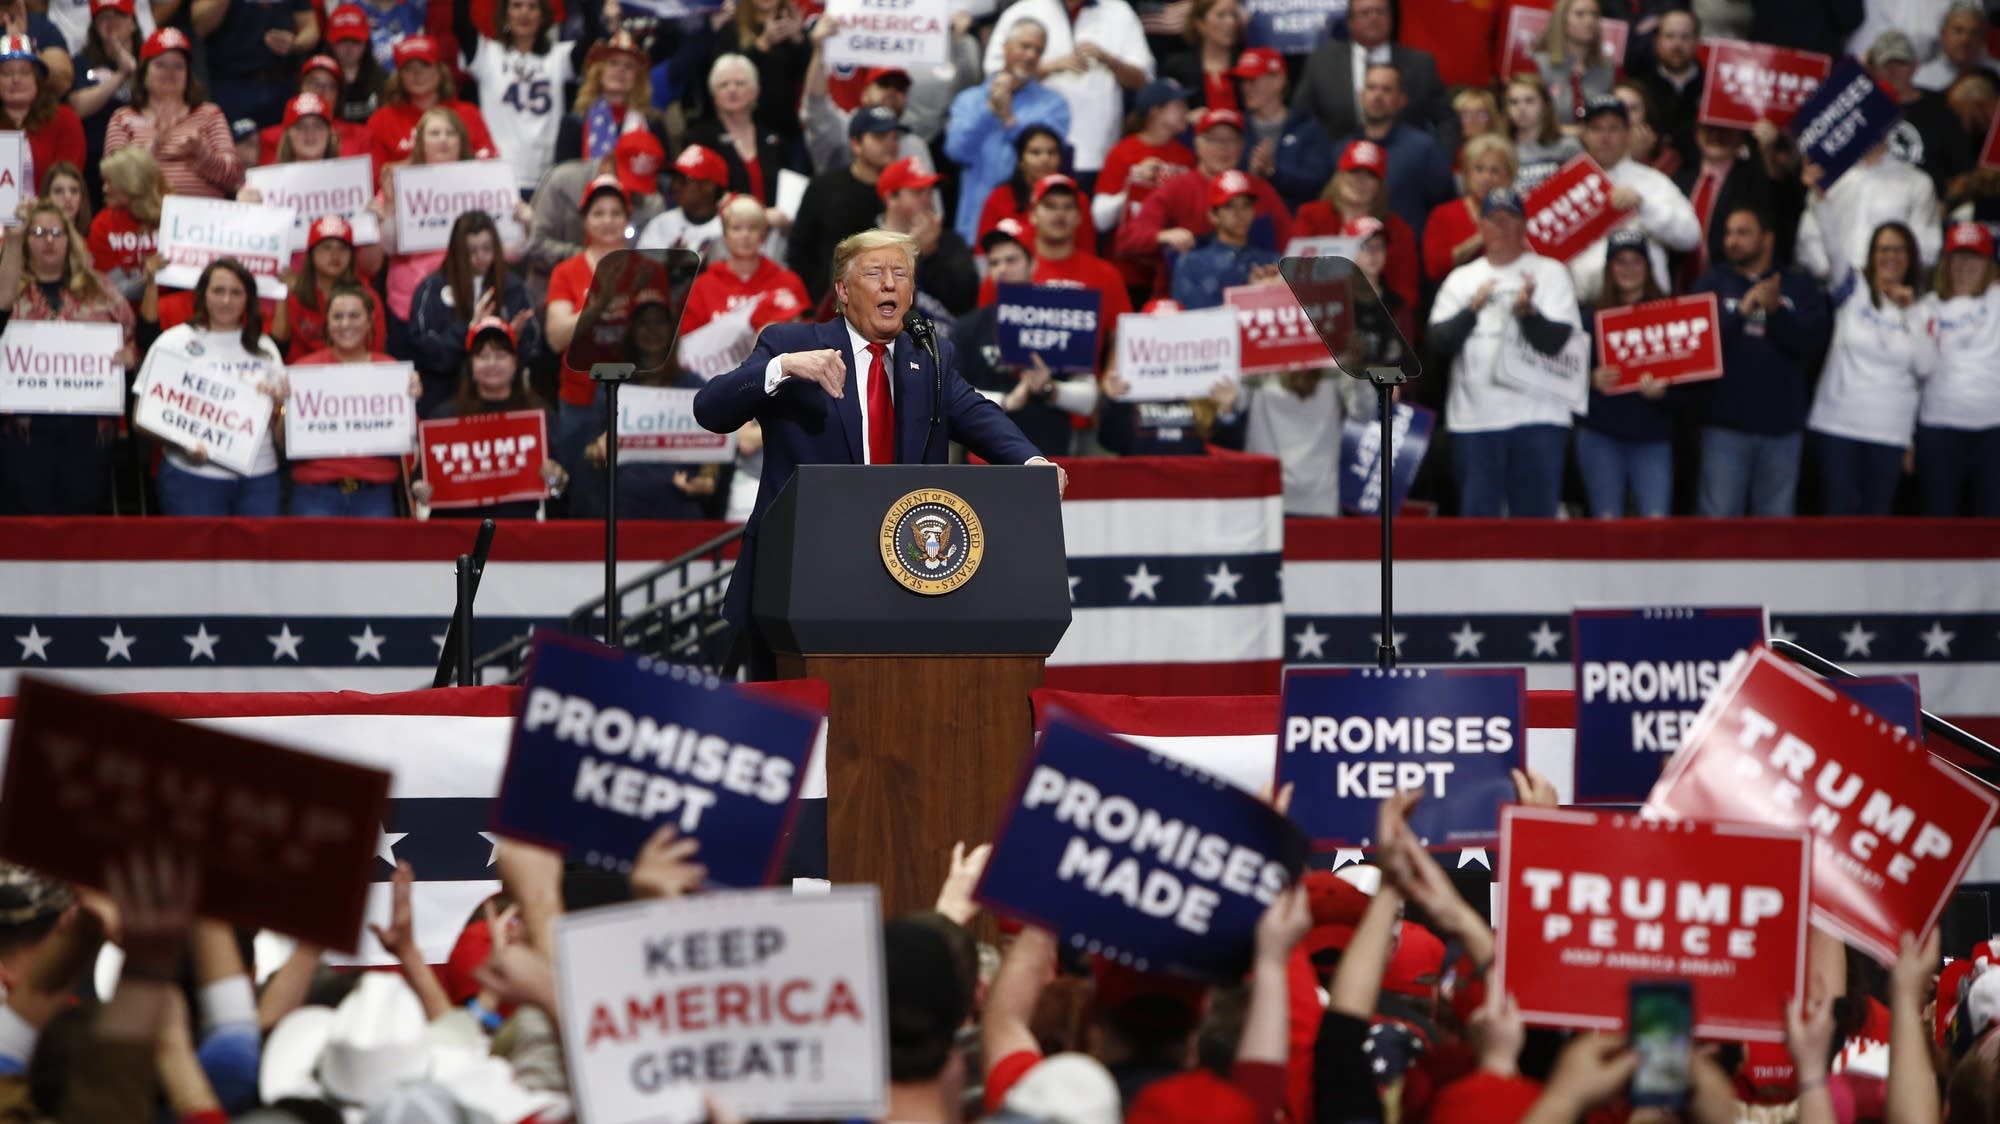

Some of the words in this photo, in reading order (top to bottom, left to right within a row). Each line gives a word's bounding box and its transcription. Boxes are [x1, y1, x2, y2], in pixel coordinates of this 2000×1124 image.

[838, 13, 942, 33] AMERICA
[849, 35, 925, 53] GREAT!
[1719, 62, 1819, 93] TRUMP
[502, 80, 553, 115] 45
[1821, 108, 1867, 155] KEPT
[405, 187, 512, 217] Women
[172, 213, 281, 250] Latinos
[998, 304, 1096, 331] PROMISES
[1606, 317, 1709, 351] TRUMP
[1019, 328, 1071, 351] KEPT
[1128, 336, 1231, 364] Women
[5, 344, 116, 376] Women
[17, 377, 49, 389] FOR
[55, 378, 104, 391] TRUMP
[181, 370, 236, 401] KEEP
[150, 382, 256, 438] AMERICA
[295, 388, 405, 419] Women
[621, 405, 694, 431] Latin
[162, 408, 235, 452] GREAT!
[307, 420, 339, 432] FOR
[345, 418, 395, 431] TRUMP
[431, 435, 536, 463] TRUMP
[932, 493, 942, 501] OF
[944, 495, 957, 507] THE
[884, 492, 930, 538] PRESIDENT
[958, 506, 981, 549] UNITED
[885, 542, 894, 557] THE
[889, 559, 898, 568] OF
[898, 566, 923, 589] SEAL
[941, 557, 977, 590] STATES
[1582, 660, 1734, 704] PROMIS
[523, 686, 796, 806] PROMISES
[1285, 716, 1514, 754] PROMISES
[1632, 710, 1704, 753] KEP
[573, 756, 718, 833] KEPT
[1336, 761, 1455, 799] KEPT
[1738, 708, 1953, 861] TRUMP
[1022, 764, 1291, 906] PROMISES
[1733, 757, 1918, 886] PENCE
[1057, 835, 1222, 936] MADE
[1522, 867, 1784, 927] TRUMP
[643, 925, 787, 978] KEEP
[1543, 914, 1757, 959] PENCE
[586, 977, 864, 1049] AMERICA
[630, 1037, 825, 1095] GREAT!
